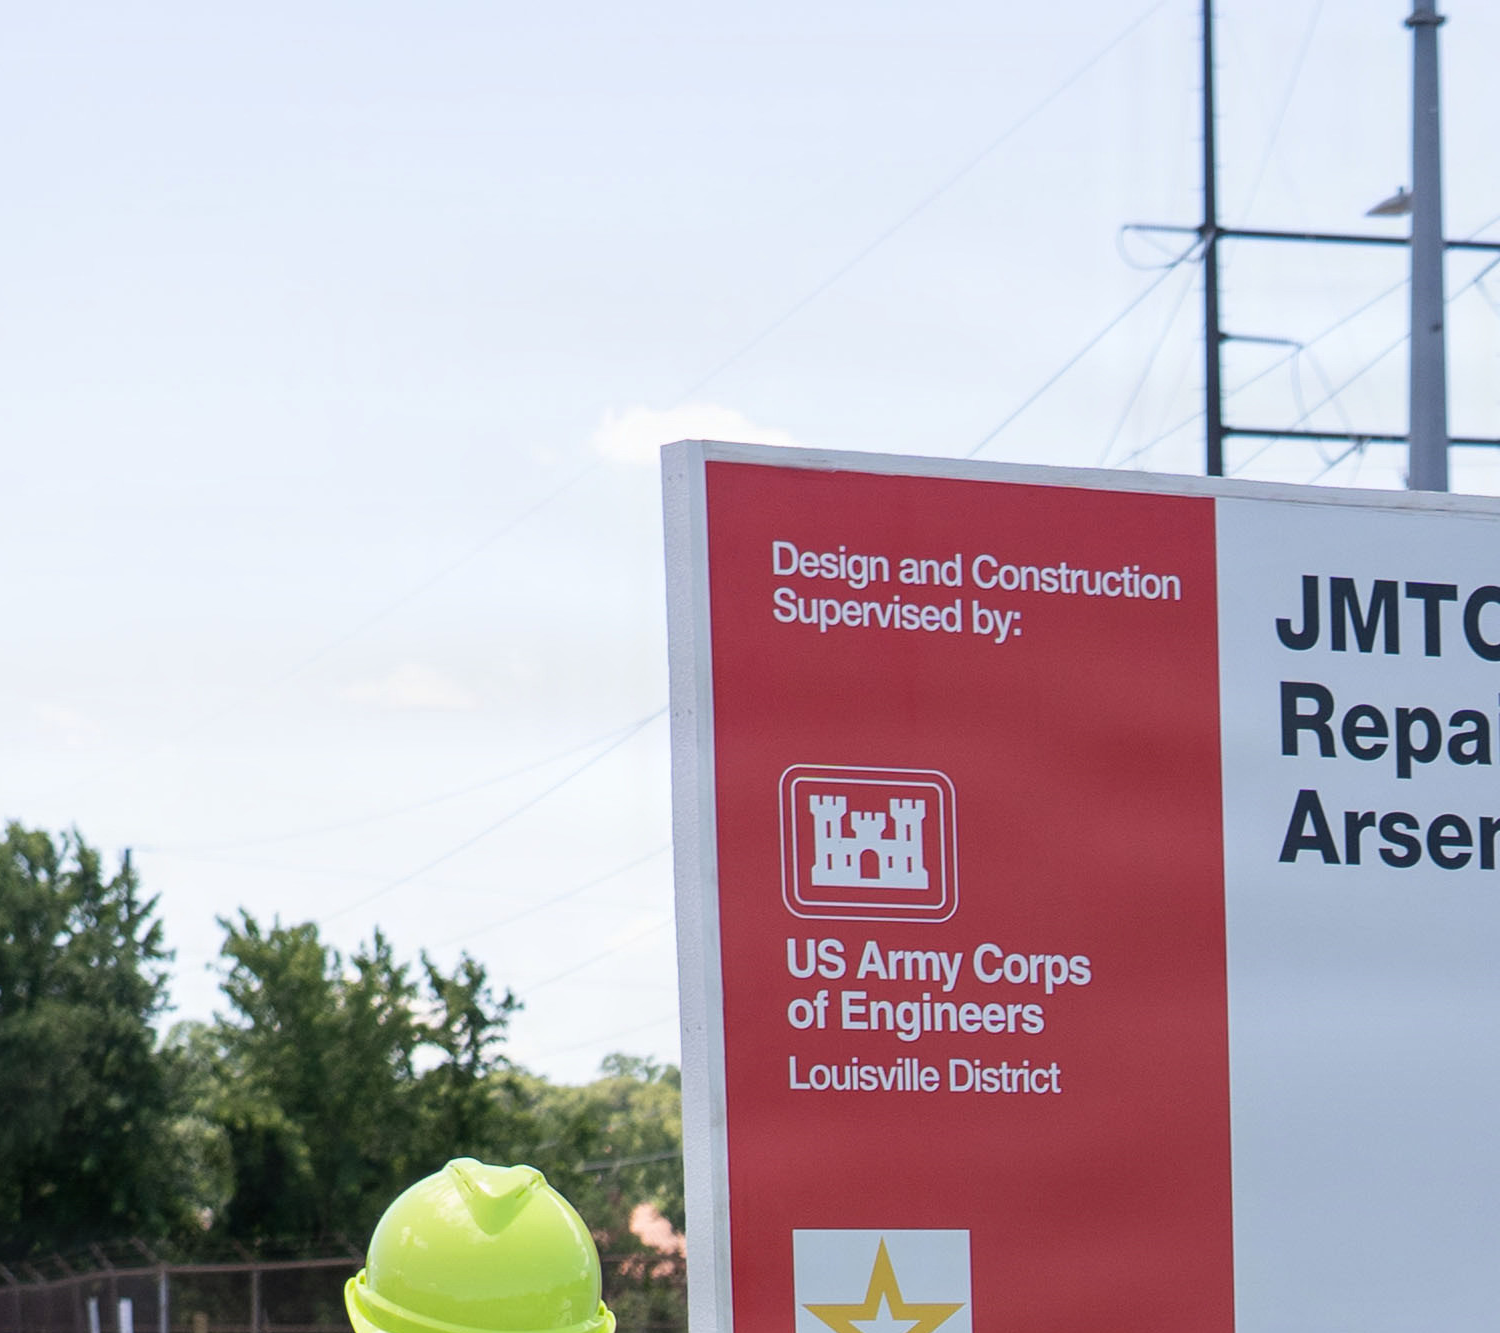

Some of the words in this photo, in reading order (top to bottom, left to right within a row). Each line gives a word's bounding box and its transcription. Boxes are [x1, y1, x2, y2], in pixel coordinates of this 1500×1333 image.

[772, 540, 890, 589] Design
[899, 554, 963, 588] and
[972, 554, 1182, 601] Construction
[772, 586, 963, 633] Supervised
[972, 600, 1023, 644] by:
[786, 937, 847, 980] US
[856, 940, 963, 993] Army
[973, 942, 1093, 995] Corps
[787, 989, 829, 1030] of
[840, 990, 1045, 1042] Engineers
[788, 1055, 941, 1092] Louisville
[948, 1058, 1063, 1094] District
